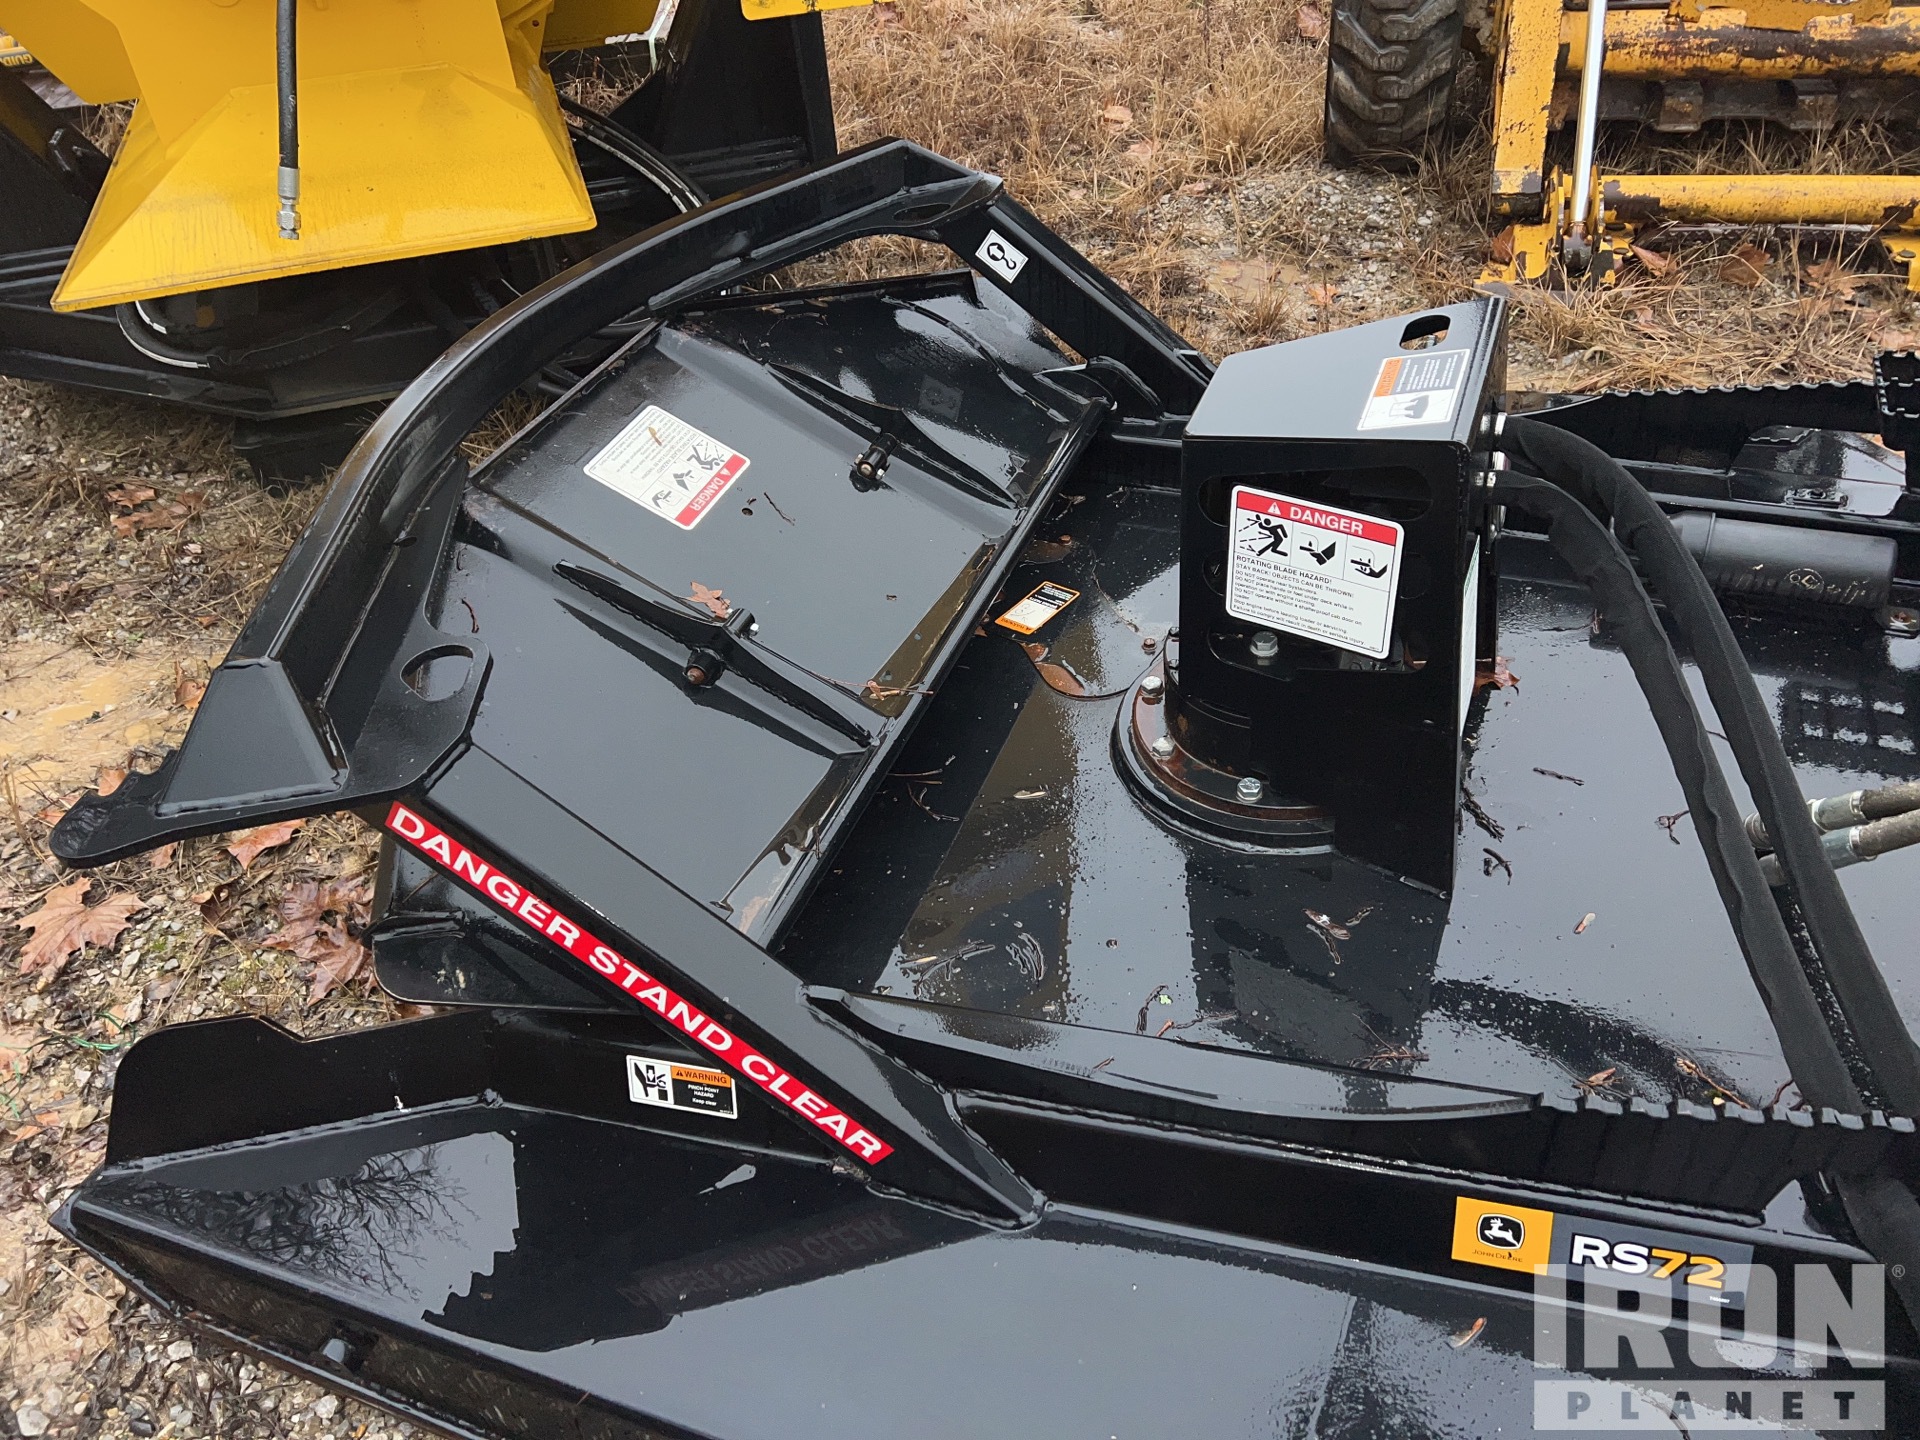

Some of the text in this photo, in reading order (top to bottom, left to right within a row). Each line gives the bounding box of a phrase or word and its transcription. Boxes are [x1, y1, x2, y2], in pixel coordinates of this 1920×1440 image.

[0, 53, 33, 66] GUID
[689, 478, 724, 511] DANGER
[1290, 506, 1364, 534] DANGER
[1235, 562, 1251, 571] STAY
[1271, 571, 1299, 583] OBJECTS
[1236, 554, 1331, 584] ROTATING BLADE HAZARD!
[391, 807, 884, 1159] DANGER STAND CLEAR
[684, 1070, 727, 1084] WARNING
[694, 1090, 714, 1098] HAZARD
[1472, 1249, 1494, 1258] JOHN
[1571, 1233, 1728, 1290] RS72
